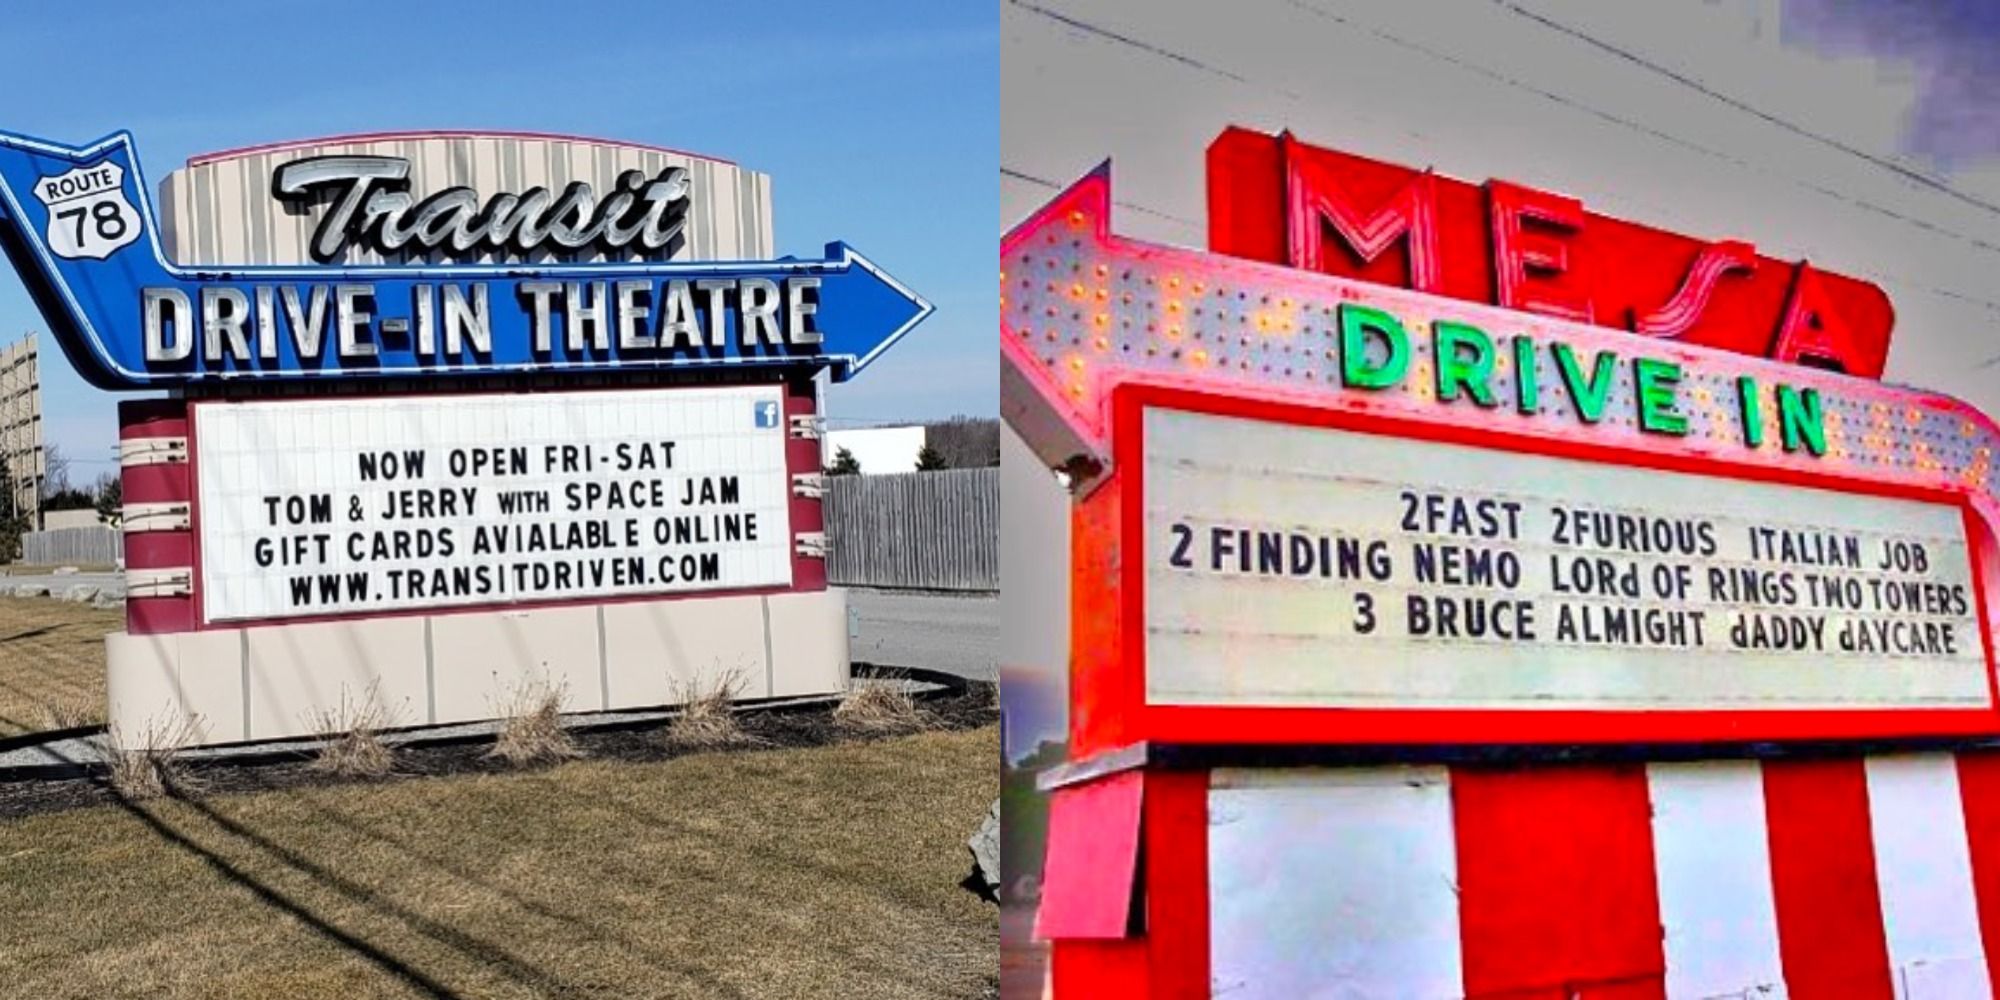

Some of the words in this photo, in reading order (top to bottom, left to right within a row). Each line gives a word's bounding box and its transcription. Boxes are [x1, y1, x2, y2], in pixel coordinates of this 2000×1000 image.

[46, 168, 114, 199] ROUTE
[272, 155, 689, 262] Transit
[57, 200, 127, 248] 78
[1280, 130, 1858, 374] MESA
[142, 283, 492, 361] DRIVE-IN
[521, 278, 824, 351] THEATRE
[1337, 303, 1687, 437] DRIVE
[1738, 376, 1826, 456] IN
[359, 450, 425, 480] NOW
[449, 447, 527, 477] OPEN
[544, 441, 675, 473] FRI-SAT
[264, 494, 332, 525] TOM
[348, 494, 364, 522] &
[381, 487, 477, 519] JERRY
[497, 490, 549, 514] WITH
[564, 479, 663, 511] SPACE
[680, 476, 739, 505] JAM
[255, 534, 330, 567] GIFT
[347, 528, 454, 561] CARDS
[473, 519, 639, 555] AVIALABLE
[654, 513, 757, 545] ONLINE
[1401, 492, 1521, 539] 2FAST
[1551, 507, 1716, 556] 2FURIOUS
[1749, 526, 1861, 568] ITALIAN
[1878, 542, 1928, 573] JOB
[290, 553, 719, 606] WWW.TRANSITDRIVEN.COM
[1169, 523, 1193, 568] 2
[1211, 527, 1392, 581] FINDING
[1414, 543, 1521, 589] NEMO
[1653, 563, 1693, 599] OF
[1707, 567, 1797, 604] RINGS
[1806, 574, 1862, 610] TWO
[1869, 578, 1968, 616] TOWERS
[1353, 593, 1376, 634] 3
[1407, 596, 1535, 641] BRUCE
[1556, 603, 1705, 646] ALMIGHT
